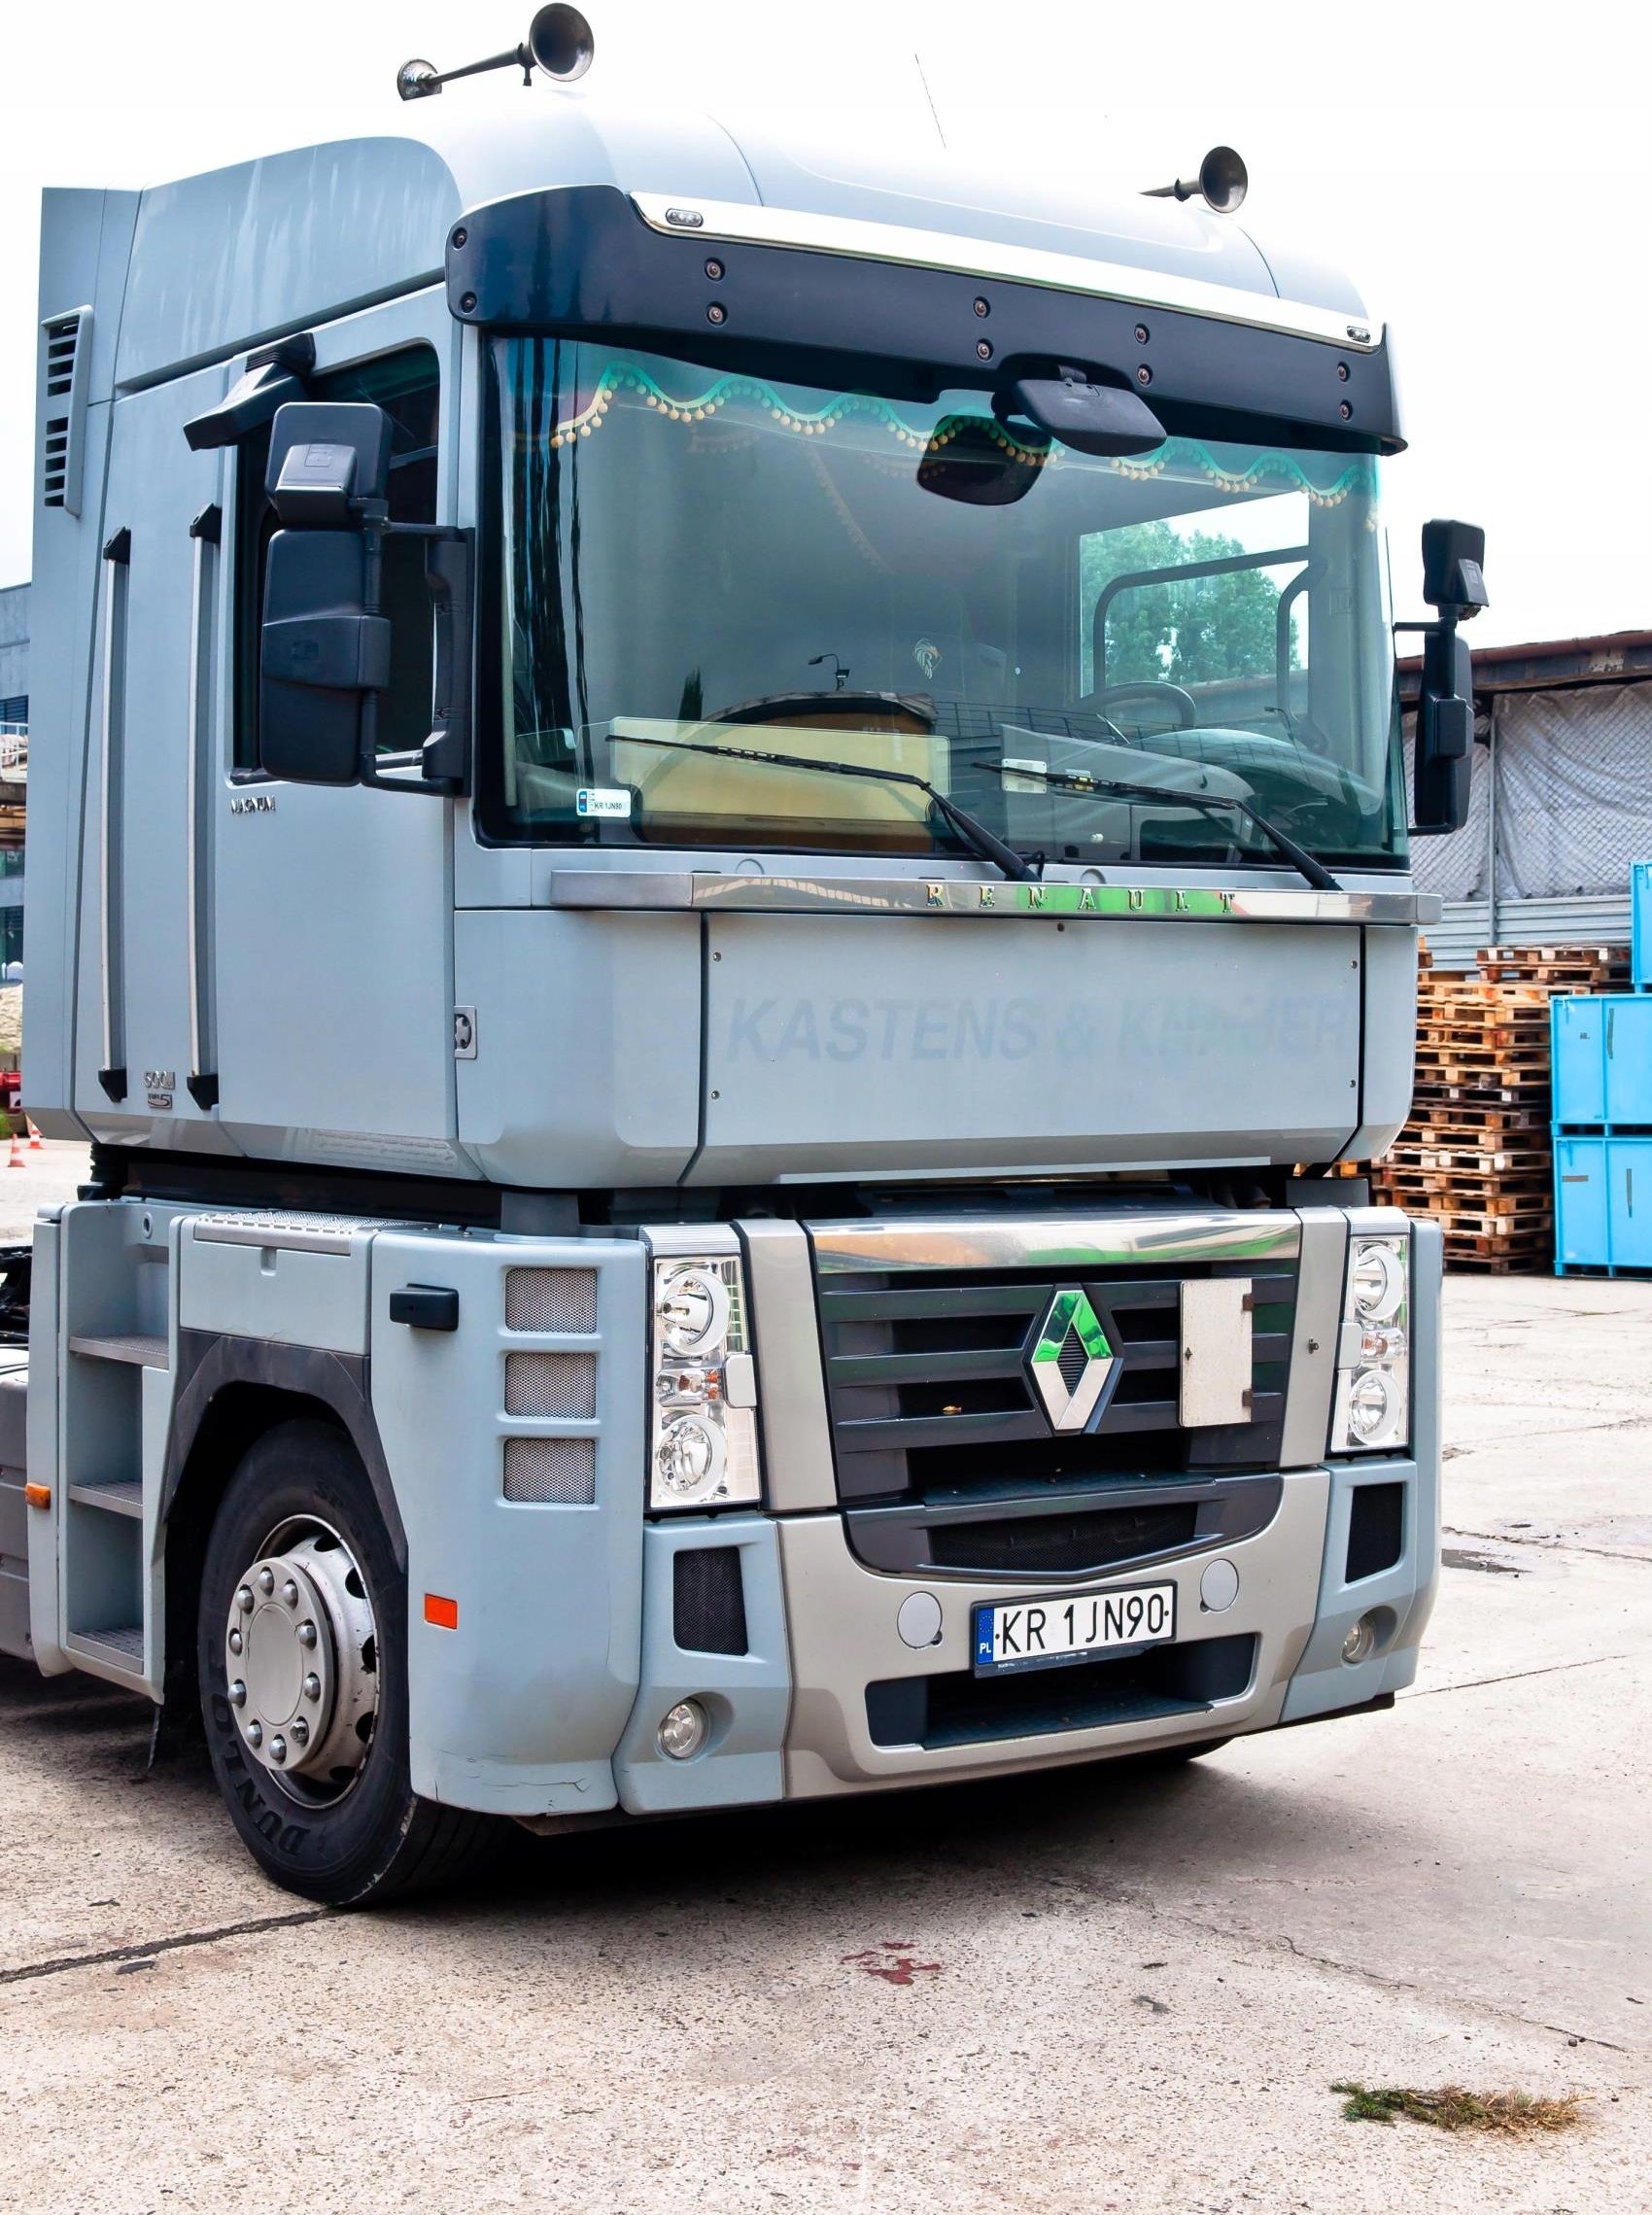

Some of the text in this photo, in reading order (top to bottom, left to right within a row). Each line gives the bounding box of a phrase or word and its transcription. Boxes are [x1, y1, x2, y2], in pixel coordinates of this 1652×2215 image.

[925, 883, 1236, 915] RENAULT
[727, 998, 1038, 1062] KASTENS
[1002, 1593, 1165, 1655] KR 1JN90
[979, 1642, 992, 1654] PL
